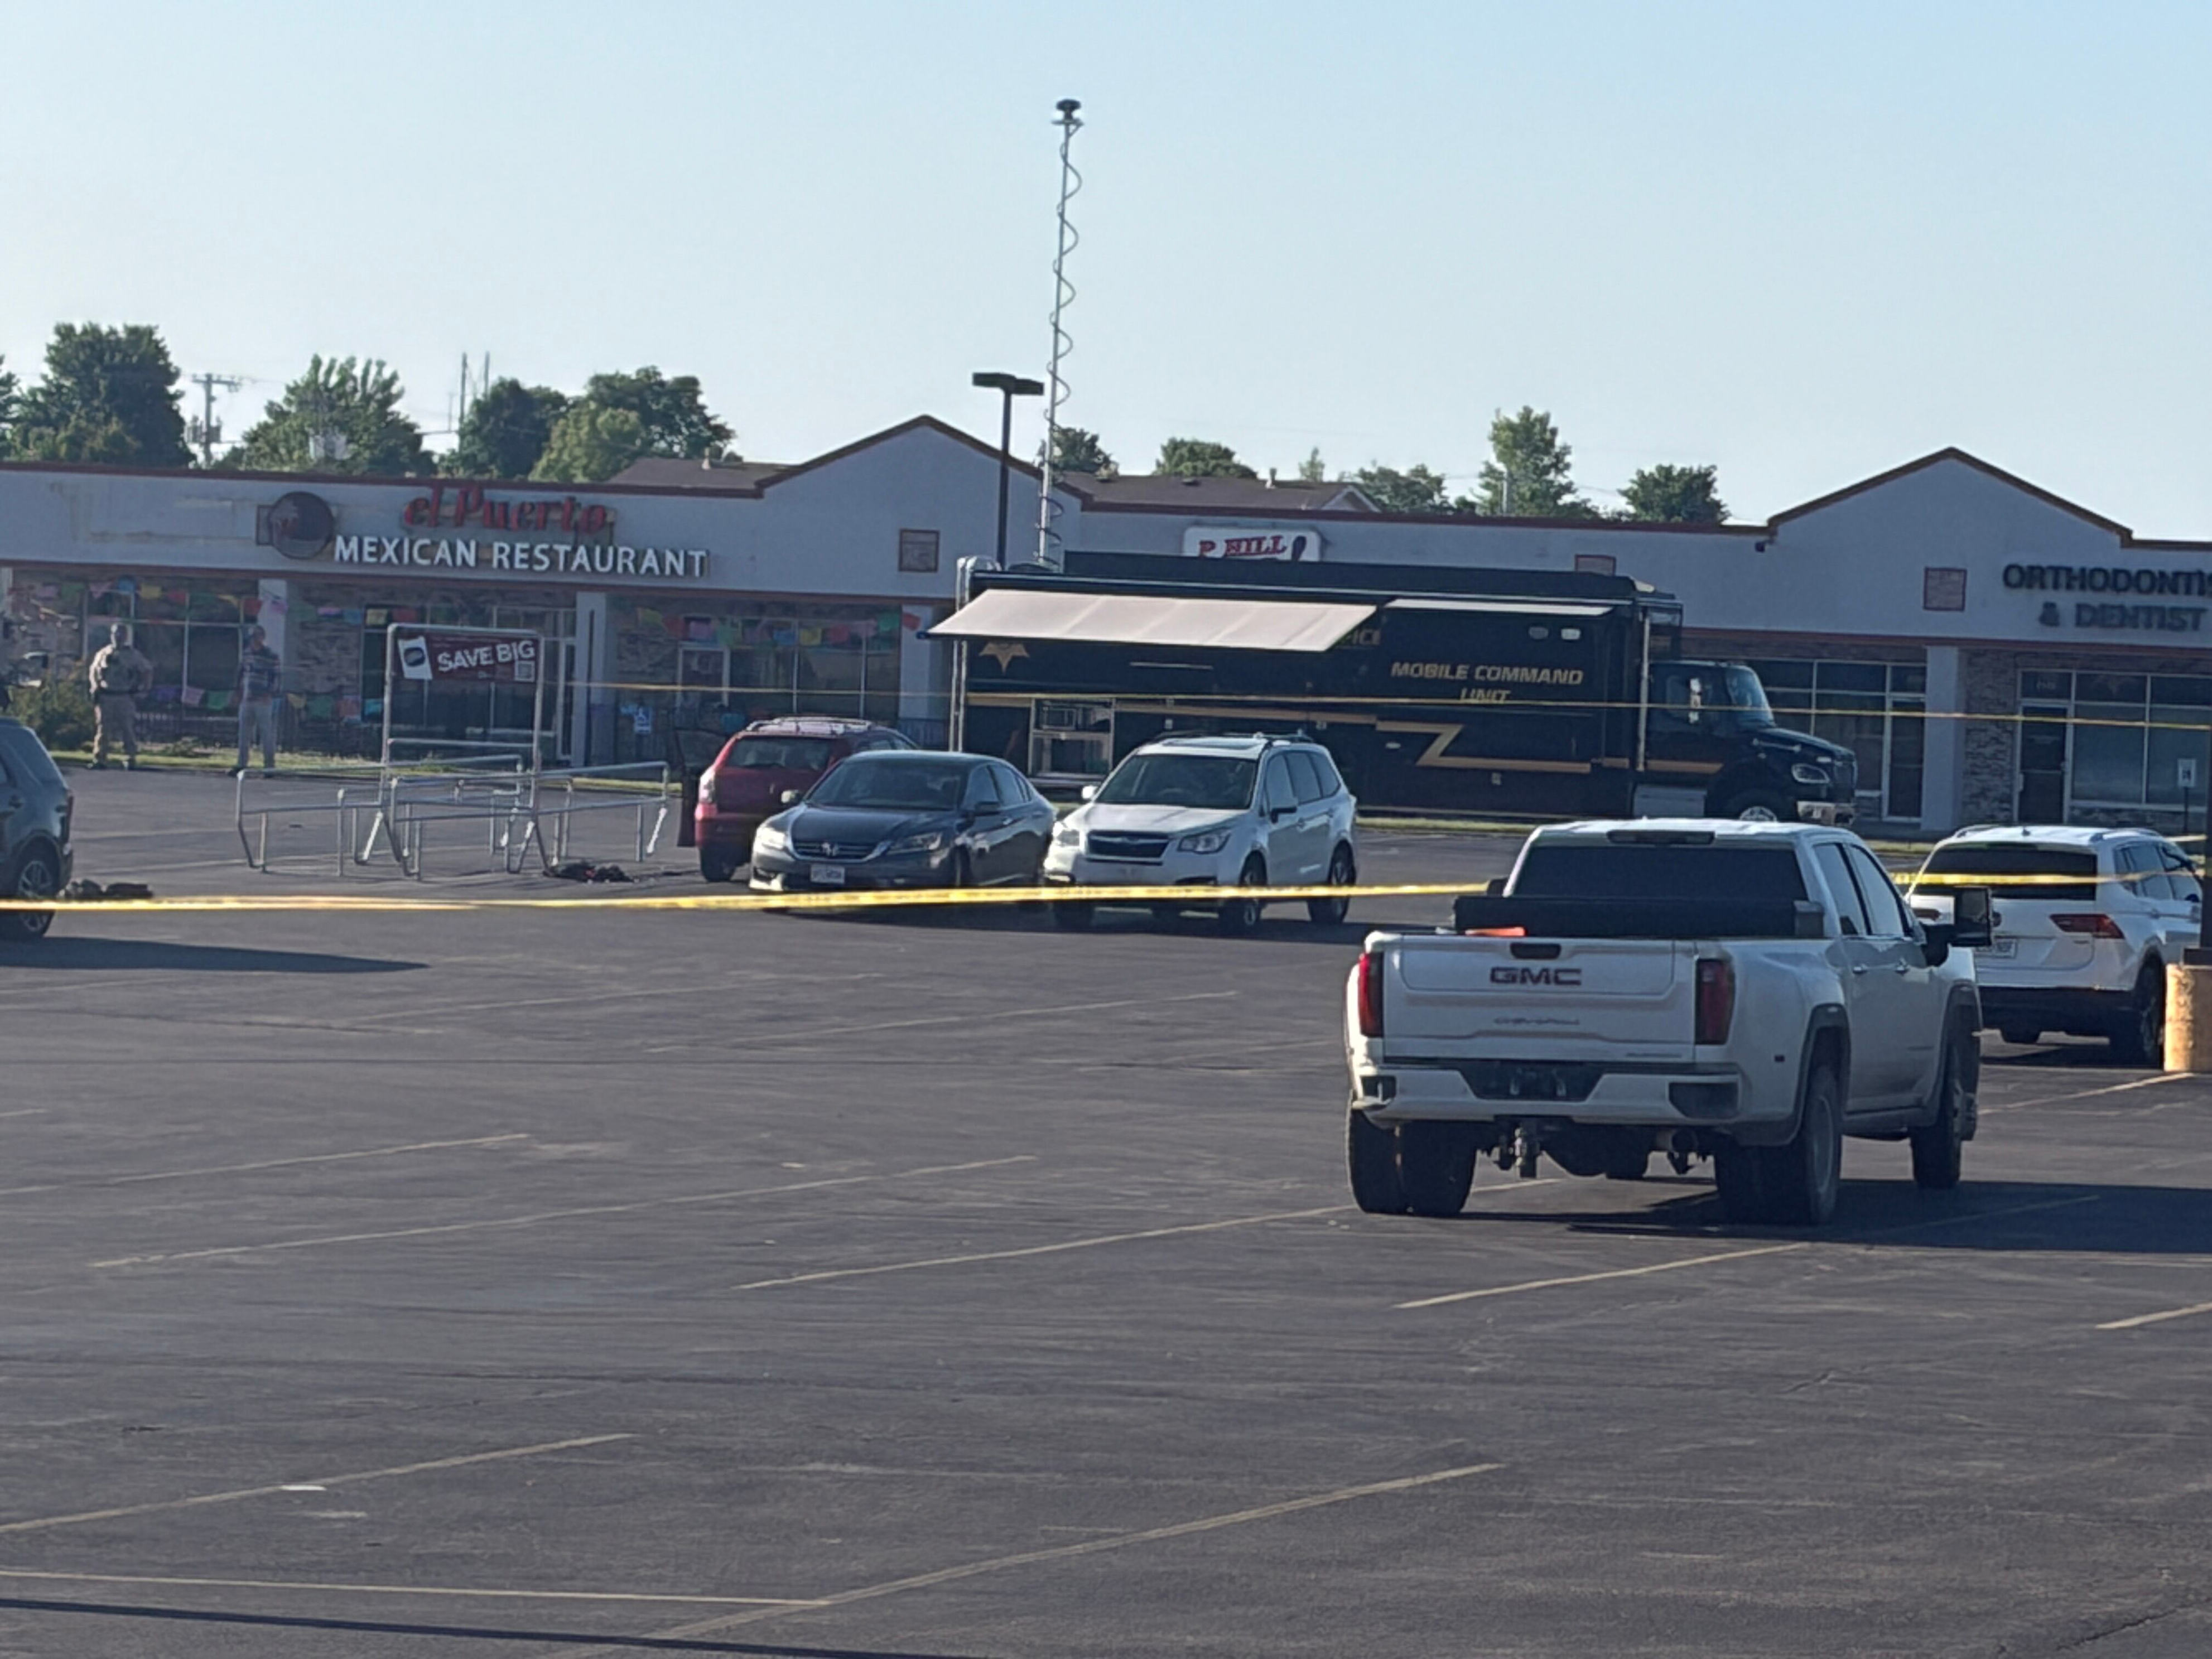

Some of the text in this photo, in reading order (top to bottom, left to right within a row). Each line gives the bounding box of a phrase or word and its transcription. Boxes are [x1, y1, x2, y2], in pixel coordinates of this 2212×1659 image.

[453, 485, 608, 534] Puerto
[335, 534, 707, 577] MEXICAN RESTAURANT
[2074, 603, 2208, 631] DENTIST
[437, 646, 495, 673] SAVE
[495, 640, 536, 663] BIG
[1390, 662, 1584, 685] MOBILE COMMAND
[1459, 687, 1511, 704] UNIT
[1490, 966, 1583, 986] GMC
